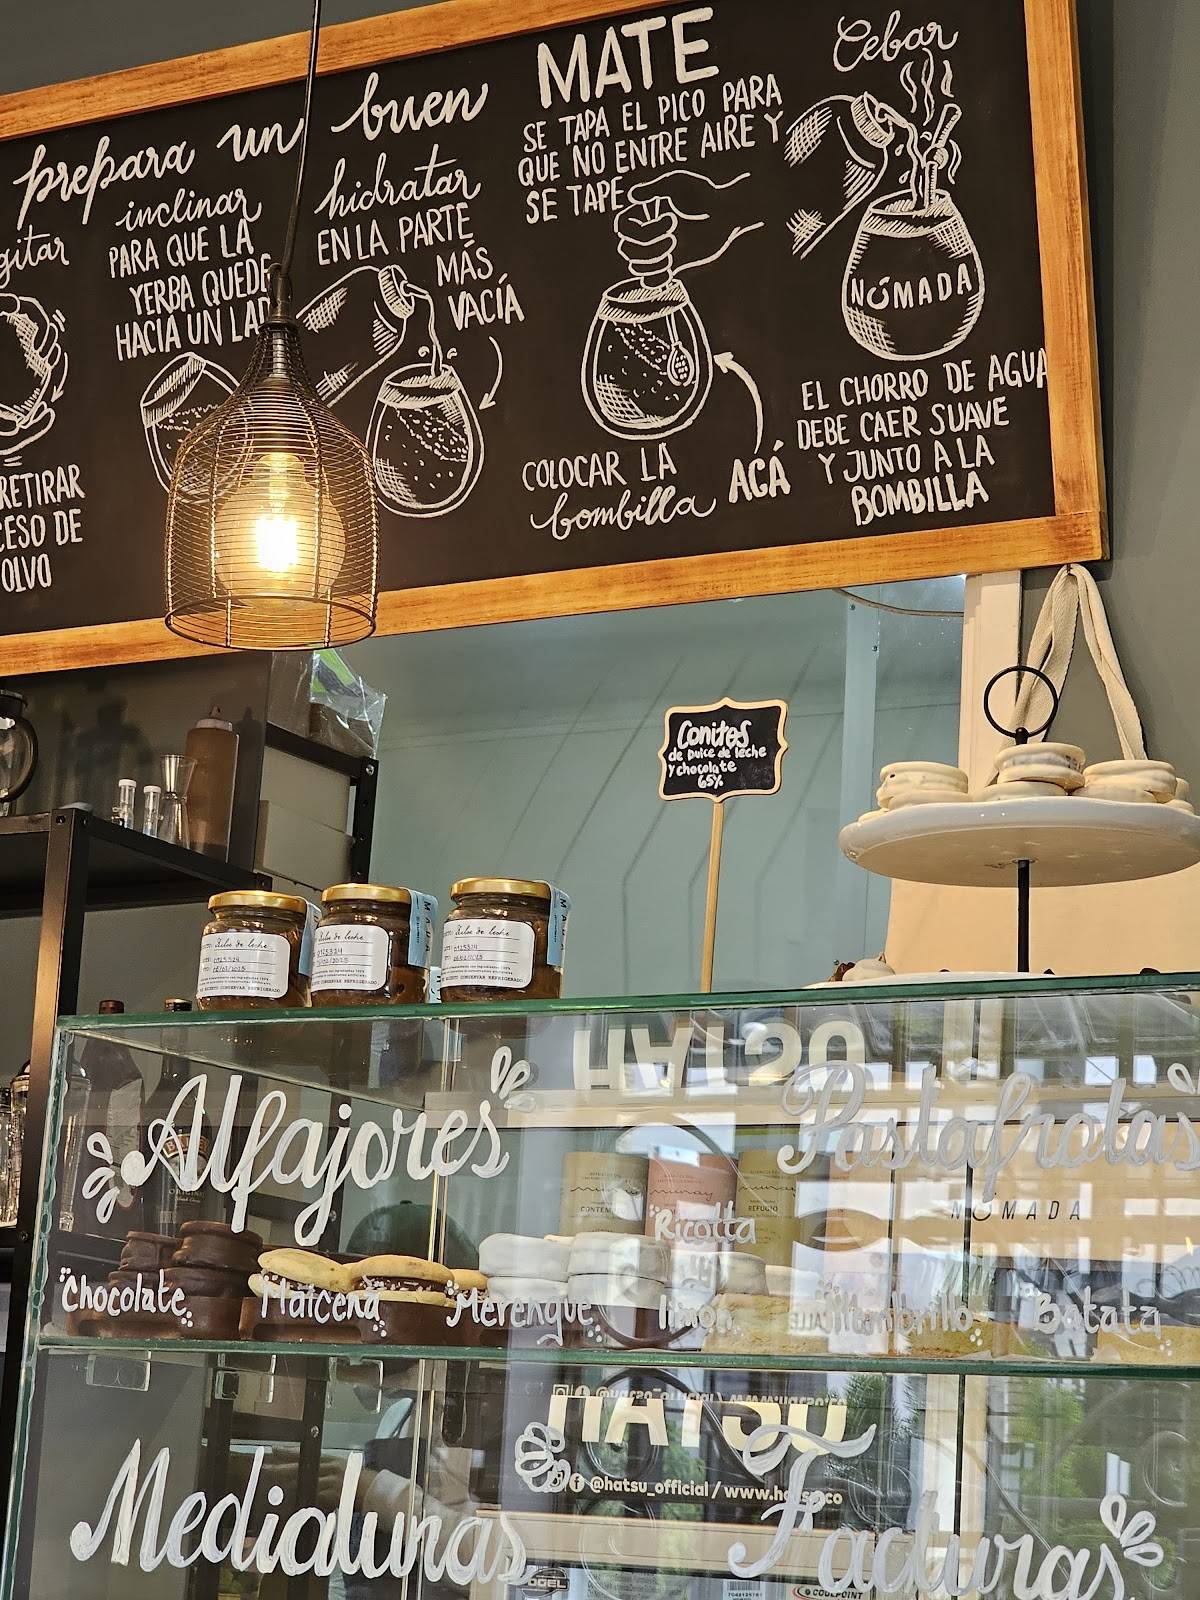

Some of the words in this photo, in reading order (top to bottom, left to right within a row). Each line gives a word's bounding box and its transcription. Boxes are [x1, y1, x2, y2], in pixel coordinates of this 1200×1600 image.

[833, 10, 958, 72] Cebar
[13, 136, 195, 230] prepara
[217, 118, 304, 161] un
[331, 72, 488, 140] buen
[537, 7, 720, 109] MATE
[524, 121, 547, 152] SE
[558, 107, 610, 145] TAPA
[623, 102, 647, 131] EL
[658, 89, 705, 124] PICO
[723, 74, 782, 113] PARA
[518, 152, 560, 186] QUE
[573, 142, 605, 177] NO
[615, 135, 688, 171] ENTRE
[701, 114, 755, 158] AIRE
[764, 111, 783, 143] Y
[115, 187, 263, 230] inclinar
[314, 144, 481, 220] hidratar
[527, 188, 557, 223] SE
[566, 176, 624, 216] TAPE
[109, 238, 159, 278] PARA
[166, 235, 212, 268] QUE
[218, 219, 254, 257] LA
[399, 202, 475, 253] PARTE
[437, 247, 493, 286] MÁS
[129, 275, 195, 315] YERBA
[448, 273, 524, 330] VACÍA
[116, 315, 181, 361] HACIA
[187, 308, 222, 345] UN
[230, 297, 270, 342] LAD
[802, 381, 829, 410] EL
[840, 369, 928, 406] CHORRO
[943, 360, 975, 393] DE
[989, 348, 1049, 391] AGUA
[797, 414, 849, 450] DEBE
[860, 406, 921, 442] CAER
[930, 396, 1009, 435] SUAVE
[522, 455, 627, 492] COLOCAR
[641, 442, 677, 481] LA
[729, 440, 790, 503] ACÁ
[818, 453, 835, 484] Y
[843, 444, 920, 482] JUNTO
[935, 440, 952, 472] A
[957, 435, 995, 468] LA
[531, 486, 716, 540] bombilla
[852, 471, 989, 526] BOMBILLA
[53, 509, 82, 545] DE
[668, 747, 684, 762] de
[717, 747, 731, 759] de
[734, 744, 768, 759] leche
[676, 760, 738, 776] chocolate
[697, 774, 724, 790] 65%
[121, 1074, 510, 1246] Alfajores
[654, 1200, 757, 1244] Ricotta
[61, 1268, 187, 1317] Chocolate
[260, 1277, 382, 1323] Maicena
[446, 1287, 595, 1346] Merengue
[1032, 1286, 1163, 1340] Batata
[70, 1439, 527, 1585] Medialunas
[590, 1472, 709, 1498] @hatsu_official
